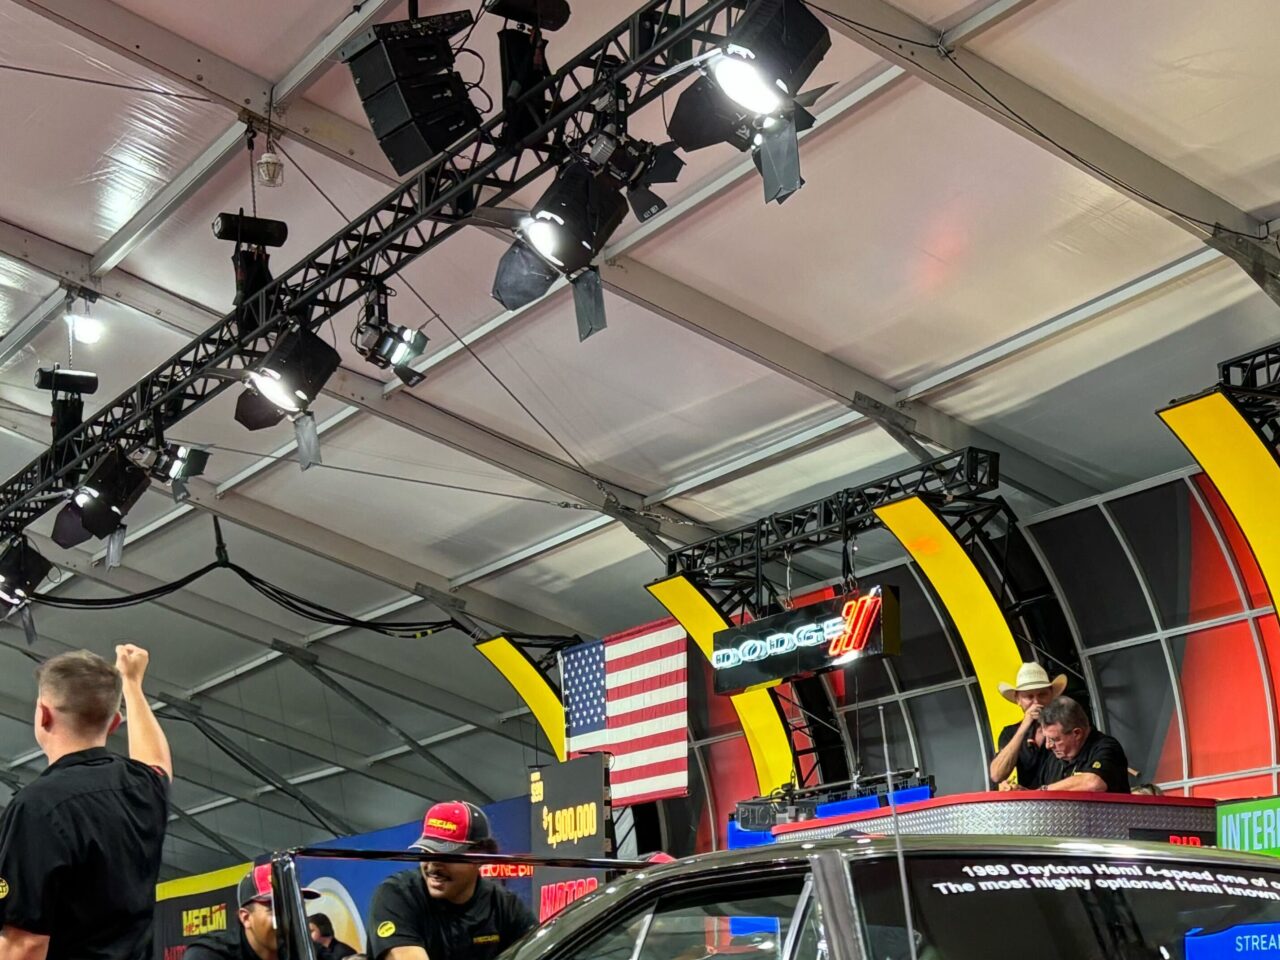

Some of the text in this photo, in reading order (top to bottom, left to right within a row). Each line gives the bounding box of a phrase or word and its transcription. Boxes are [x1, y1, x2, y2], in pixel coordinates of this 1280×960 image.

[712, 616, 849, 669] DODGE
[962, 864, 1010, 877] 1969
[1011, 864, 1093, 877] Daytona
[1092, 864, 1143, 877] Hemi
[1145, 865, 1214, 881] 4-speed
[1216, 871, 1249, 885] one
[1250, 876, 1269, 888] of
[932, 881, 976, 895] The
[978, 878, 1031, 891] most
[1030, 877, 1091, 890] highly
[1095, 877, 1176, 891] optioned
[1174, 880, 1223, 894] Hemi
[1222, 884, 1280, 900] known
